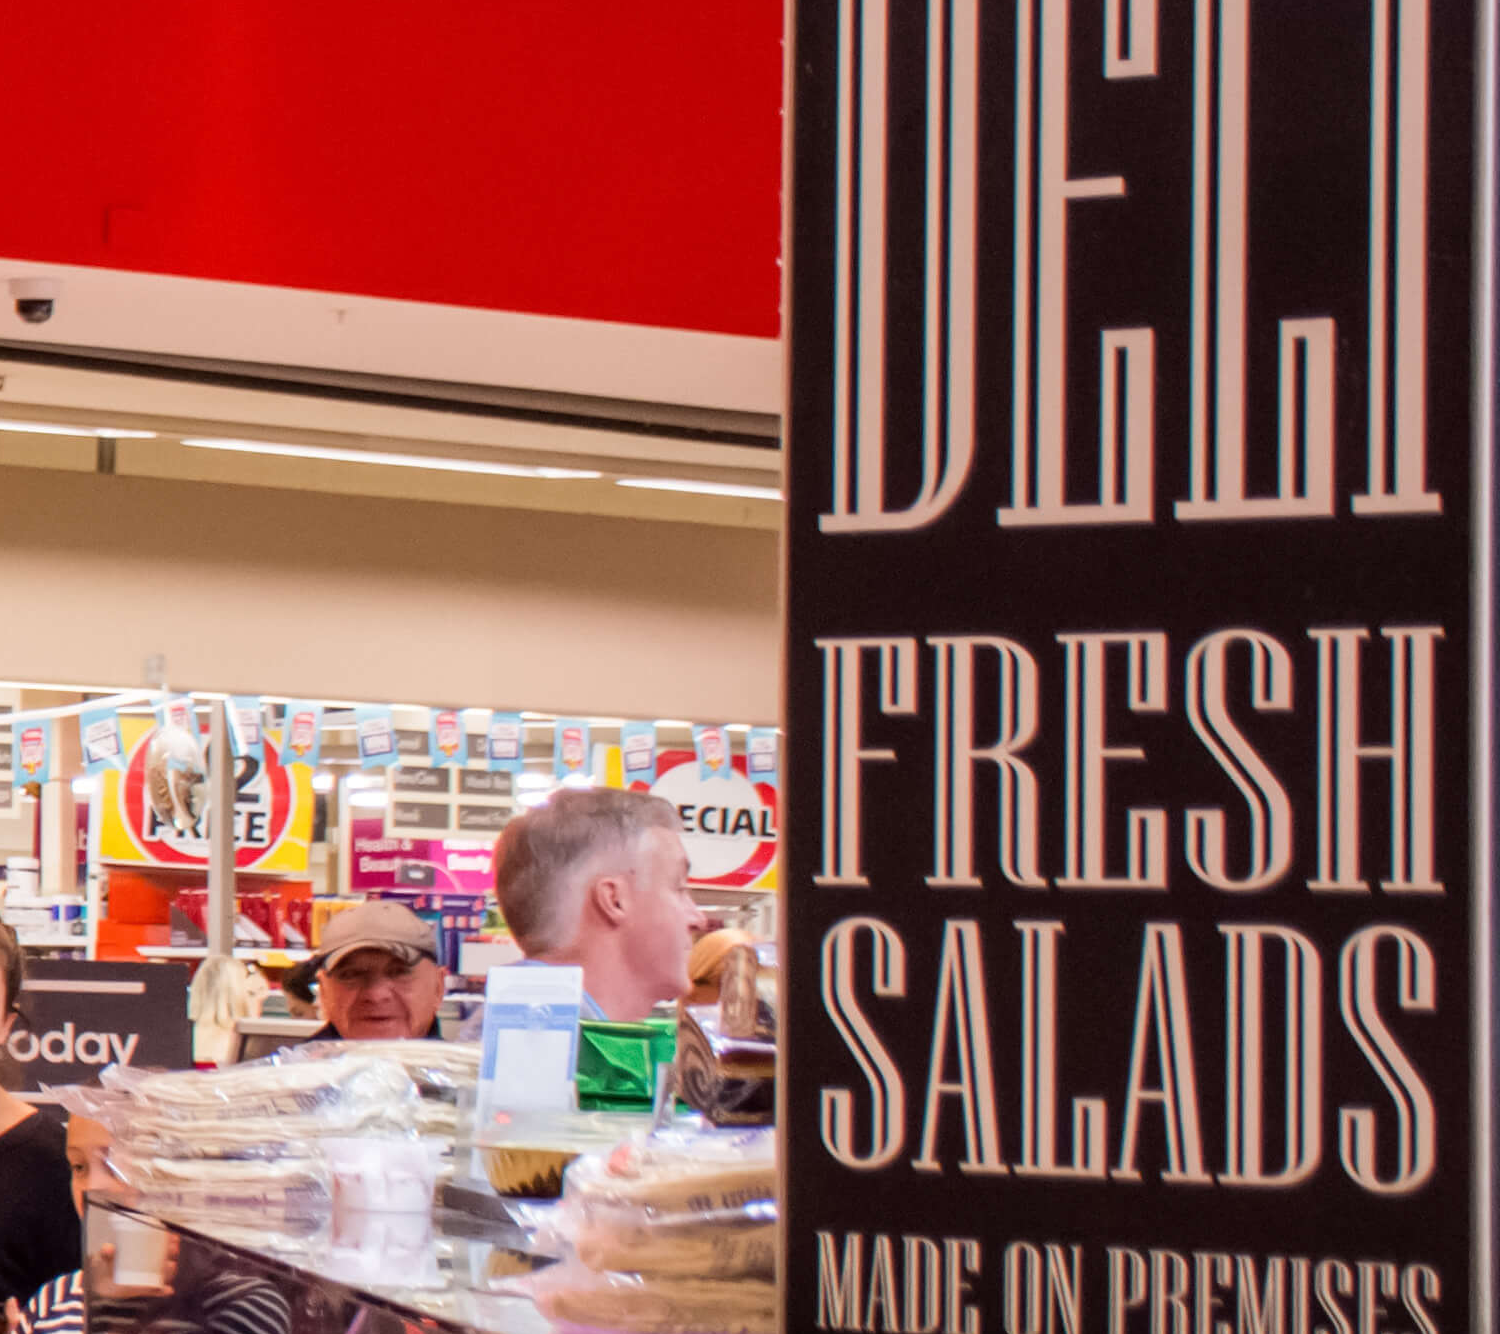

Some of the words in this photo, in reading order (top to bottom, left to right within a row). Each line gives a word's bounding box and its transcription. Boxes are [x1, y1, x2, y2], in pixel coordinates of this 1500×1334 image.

[678, 805, 777, 838] ECIAL
[813, 626, 1446, 894] FRESH
[7, 1021, 140, 1067] oday
[819, 914, 1442, 1194] SALADS
